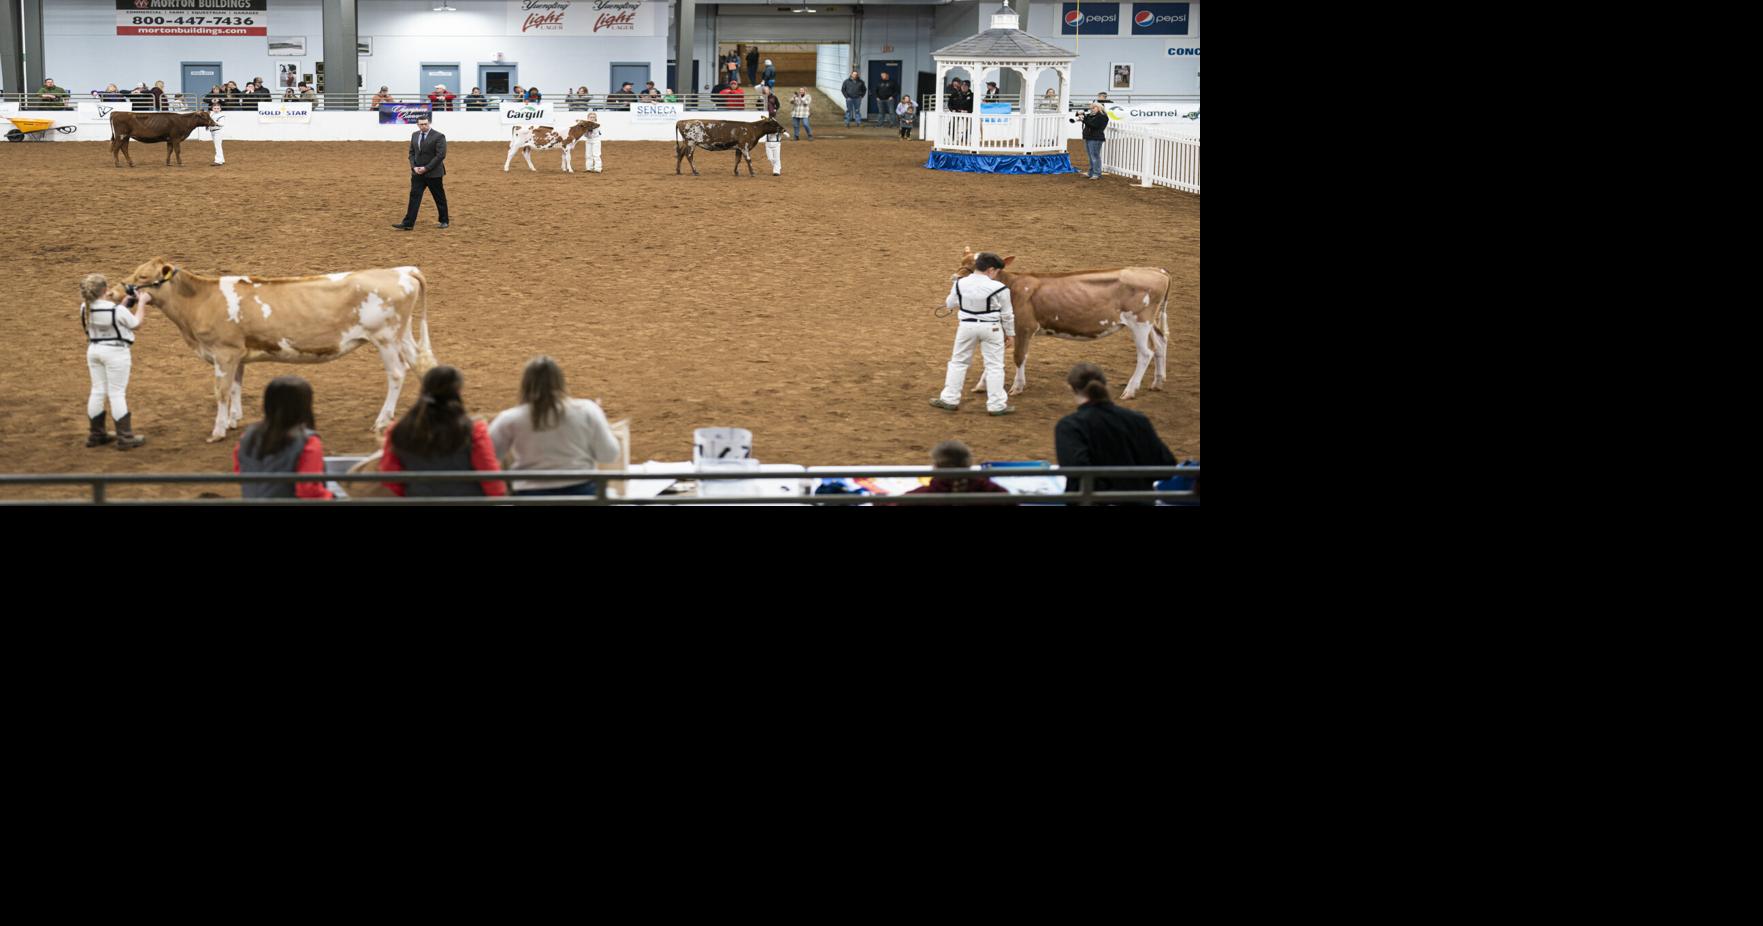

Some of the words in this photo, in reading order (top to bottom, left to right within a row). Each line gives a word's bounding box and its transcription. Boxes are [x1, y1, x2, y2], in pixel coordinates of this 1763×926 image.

[150, 0, 196, 8] MORTON
[199, 0, 251, 8] BUILDINGS
[521, 0, 570, 11] Yuengling
[592, 0, 641, 11] Yuengling
[132, 16, 254, 26] 800-447-7436
[522, 10, 565, 33] Light
[593, 10, 636, 33] Light
[1086, 13, 1117, 23] pepsi
[1156, 13, 1187, 23] pepsi
[138, 26, 247, 35] mortonbuildings.com
[1167, 47, 1200, 56] CONC
[637, 105, 677, 114] SENECA
[1130, 109, 1178, 117] Channel
[506, 109, 544, 121] Cargill
